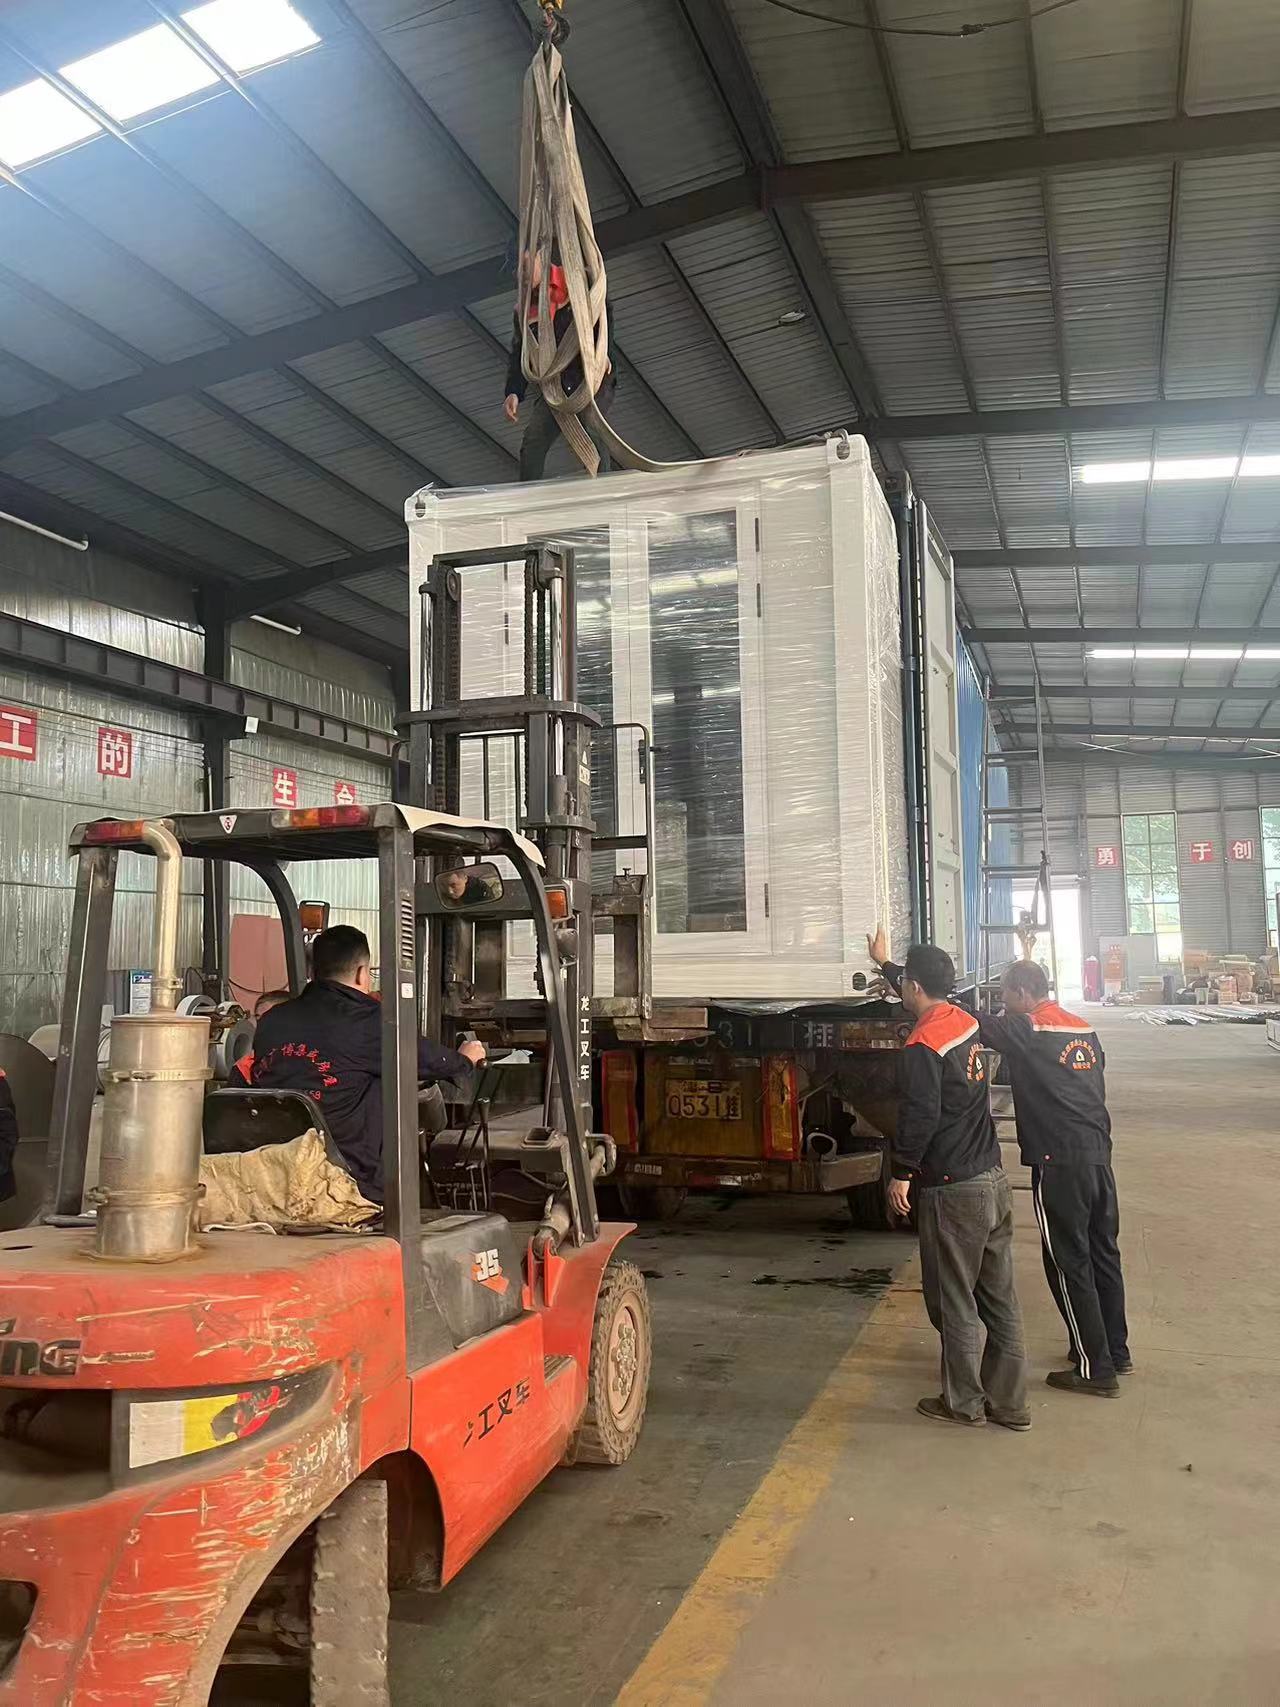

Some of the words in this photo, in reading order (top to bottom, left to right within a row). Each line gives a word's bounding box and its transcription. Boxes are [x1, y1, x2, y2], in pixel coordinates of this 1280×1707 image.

[101, 732, 129, 778] 的
[275, 772, 295, 806] 生
[1098, 848, 1114, 865] 勇
[1192, 843, 1211, 861] 于
[1233, 841, 1251, 860] 创
[580, 995, 590, 1081] 龙工叉车
[475, 1248, 500, 1282] 35
[463, 1377, 530, 1450] 工叉车
